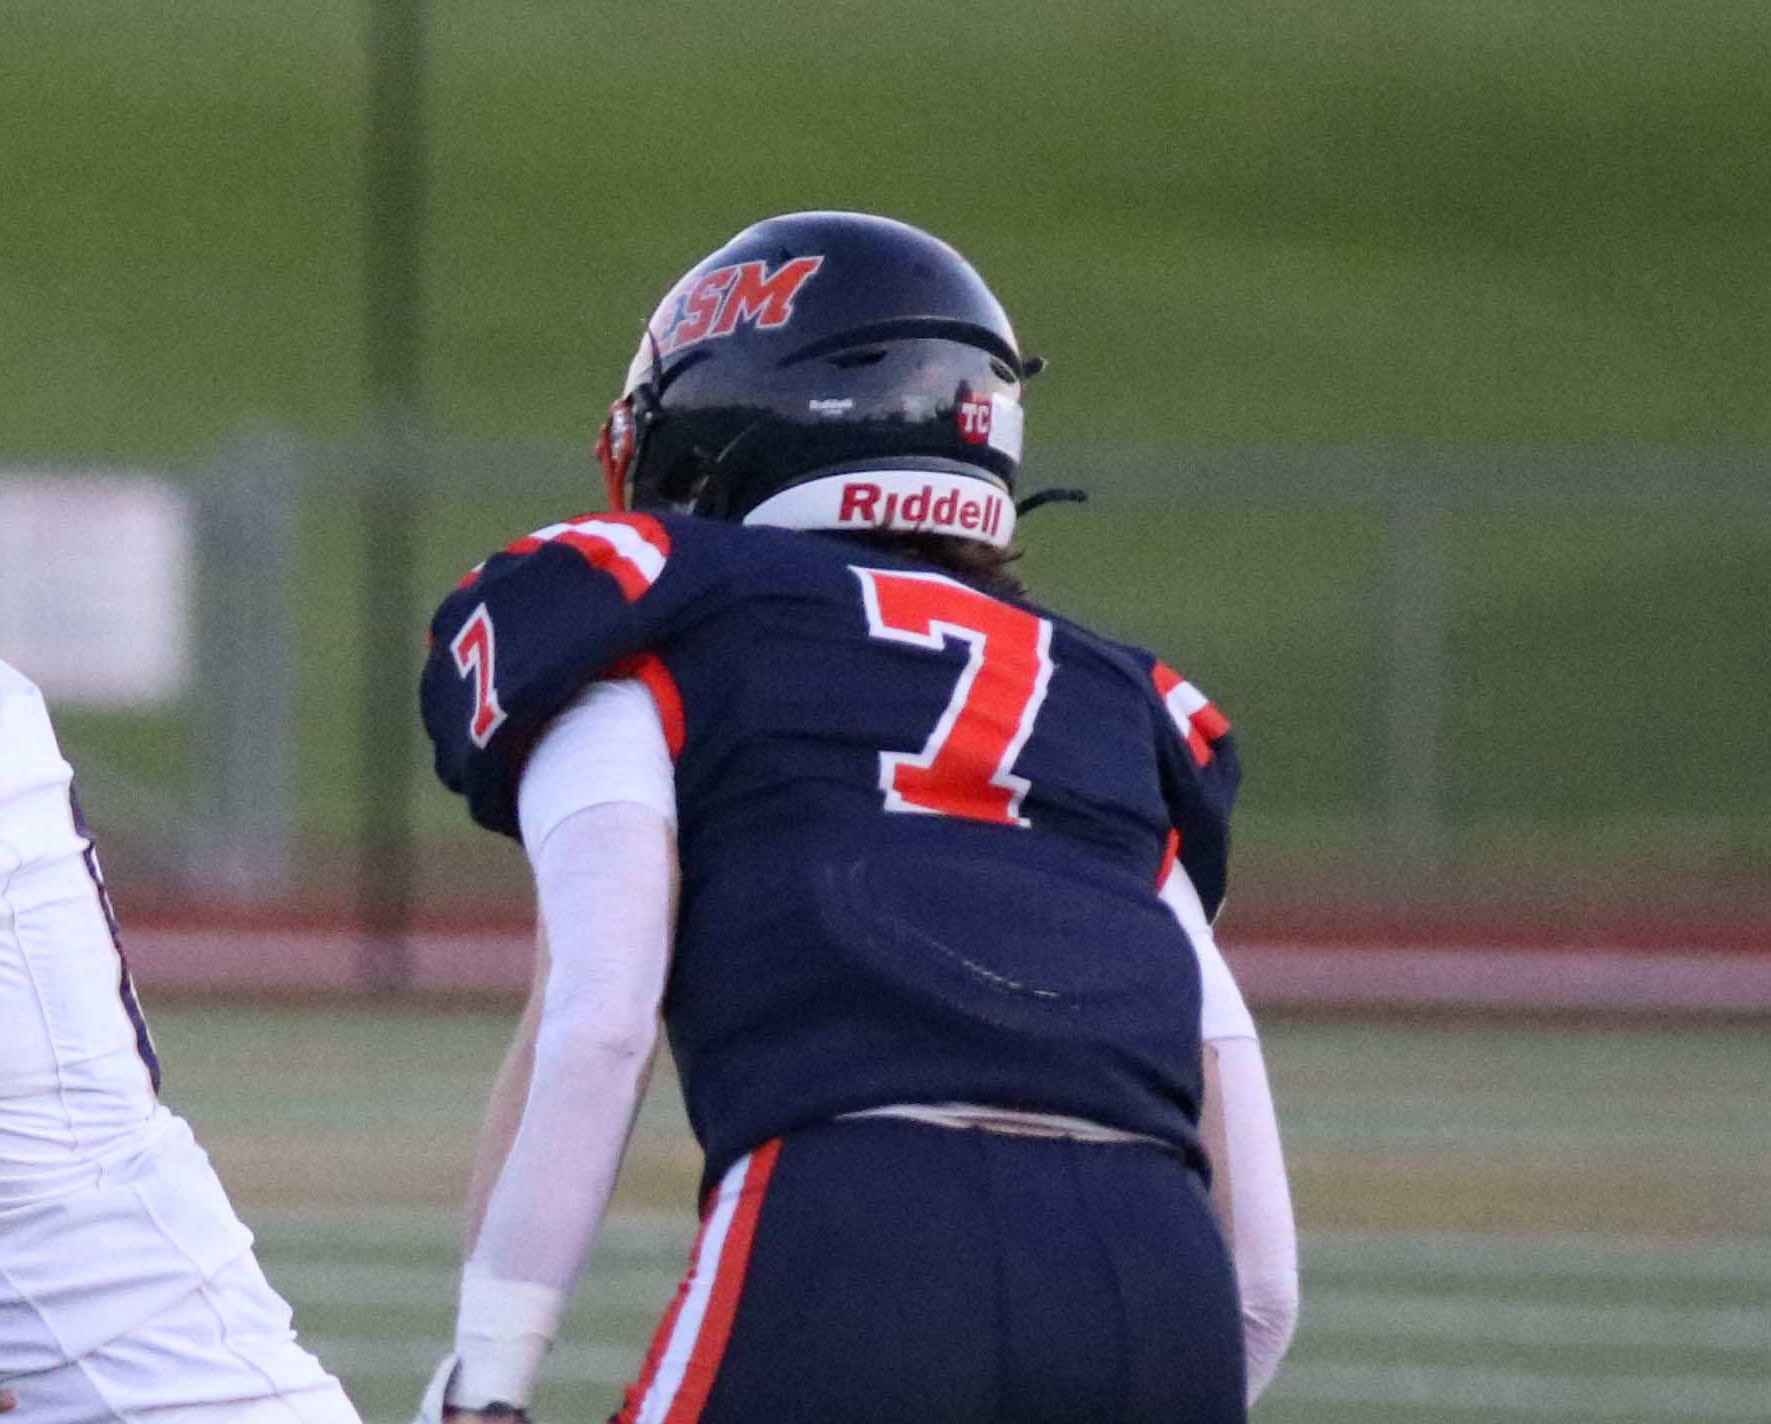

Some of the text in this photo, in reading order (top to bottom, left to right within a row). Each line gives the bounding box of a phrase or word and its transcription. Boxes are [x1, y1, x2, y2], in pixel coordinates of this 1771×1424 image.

[961, 402, 990, 433] TC
[839, 483, 1003, 537] Riddell
[450, 603, 509, 749] 7
[847, 565, 1055, 828] 7
